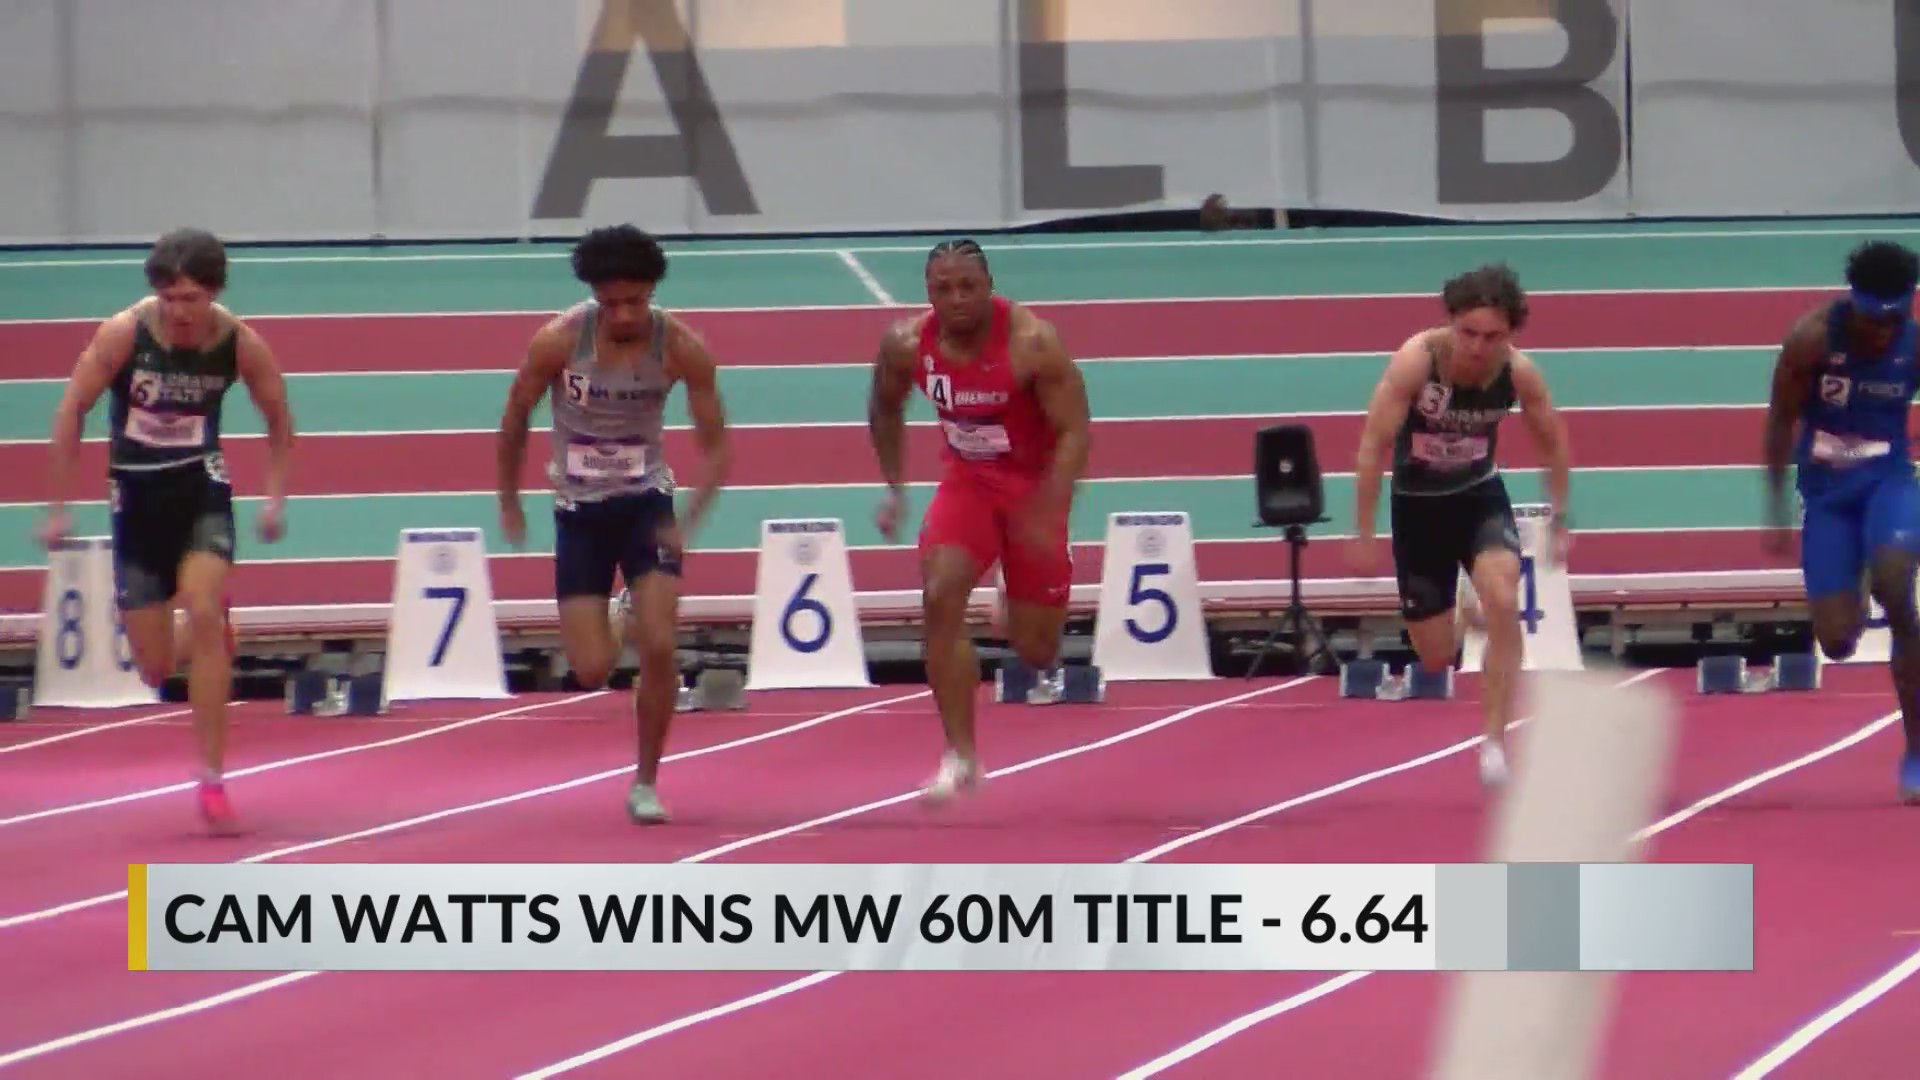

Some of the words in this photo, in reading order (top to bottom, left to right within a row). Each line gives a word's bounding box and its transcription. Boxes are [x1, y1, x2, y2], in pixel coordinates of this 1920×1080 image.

[136, 379, 154, 402] 6
[568, 375, 584, 400] 5
[933, 378, 947, 406] 4
[1422, 386, 1445, 415] 3
[1824, 376, 1844, 402] 2
[779, 573, 832, 653] 6
[1122, 562, 1179, 643] 5
[55, 589, 84, 670] 8
[423, 586, 468, 667] 7
